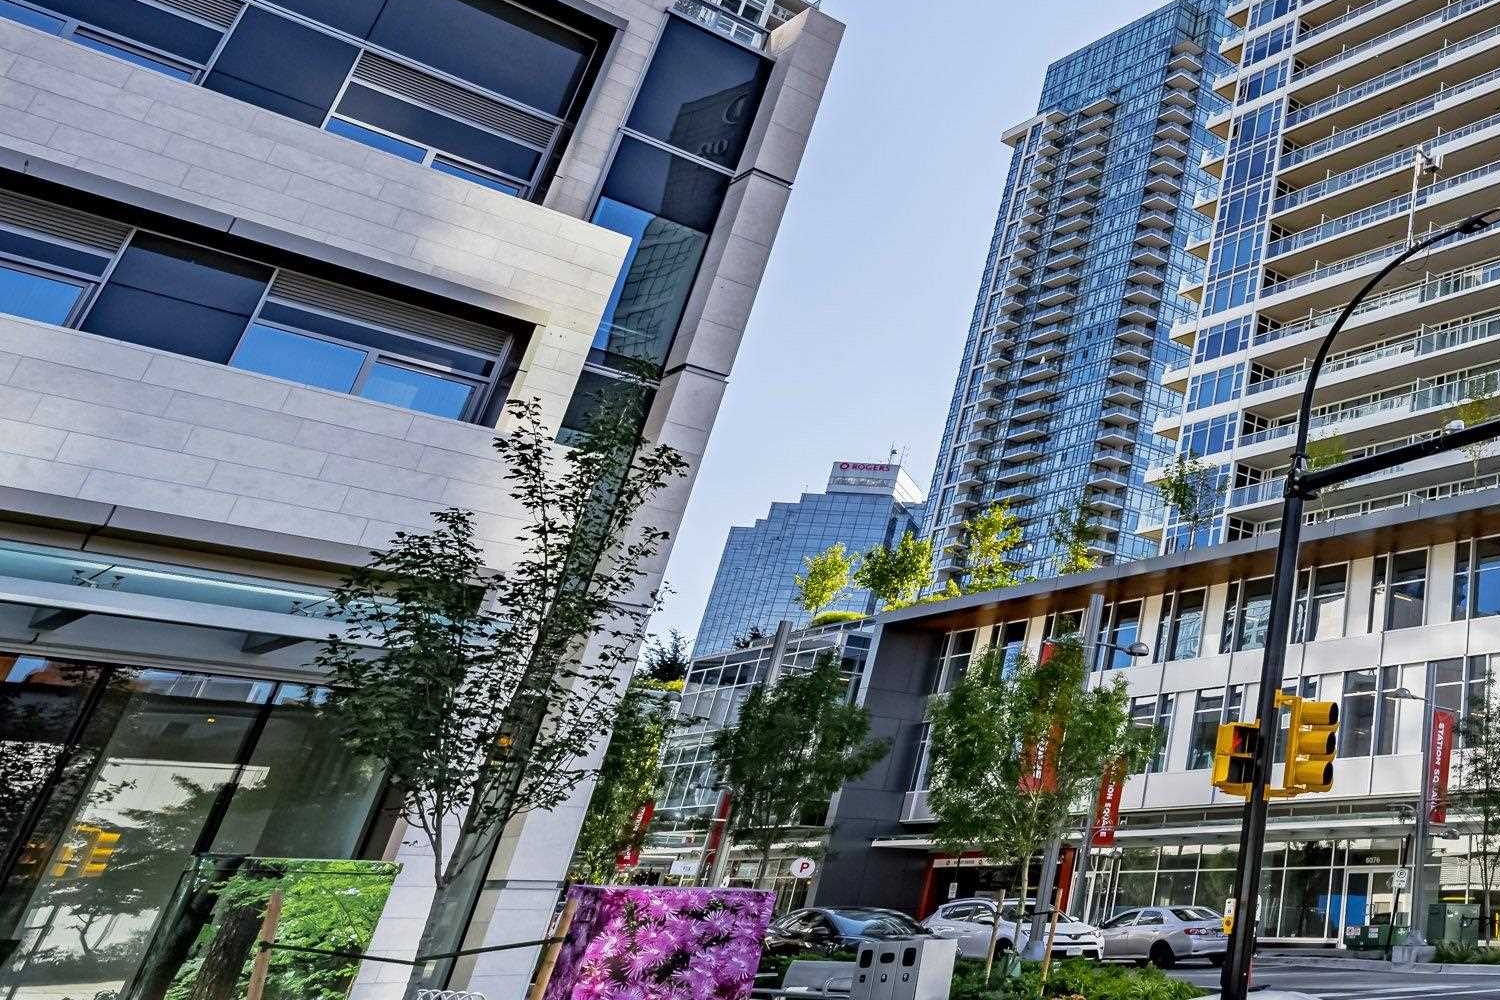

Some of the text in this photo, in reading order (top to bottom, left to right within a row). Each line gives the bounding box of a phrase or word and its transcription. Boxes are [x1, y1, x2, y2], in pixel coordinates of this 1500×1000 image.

[851, 463, 890, 472] ROGERS
[1434, 722, 1445, 765] STATION
[799, 862, 810, 873] P
